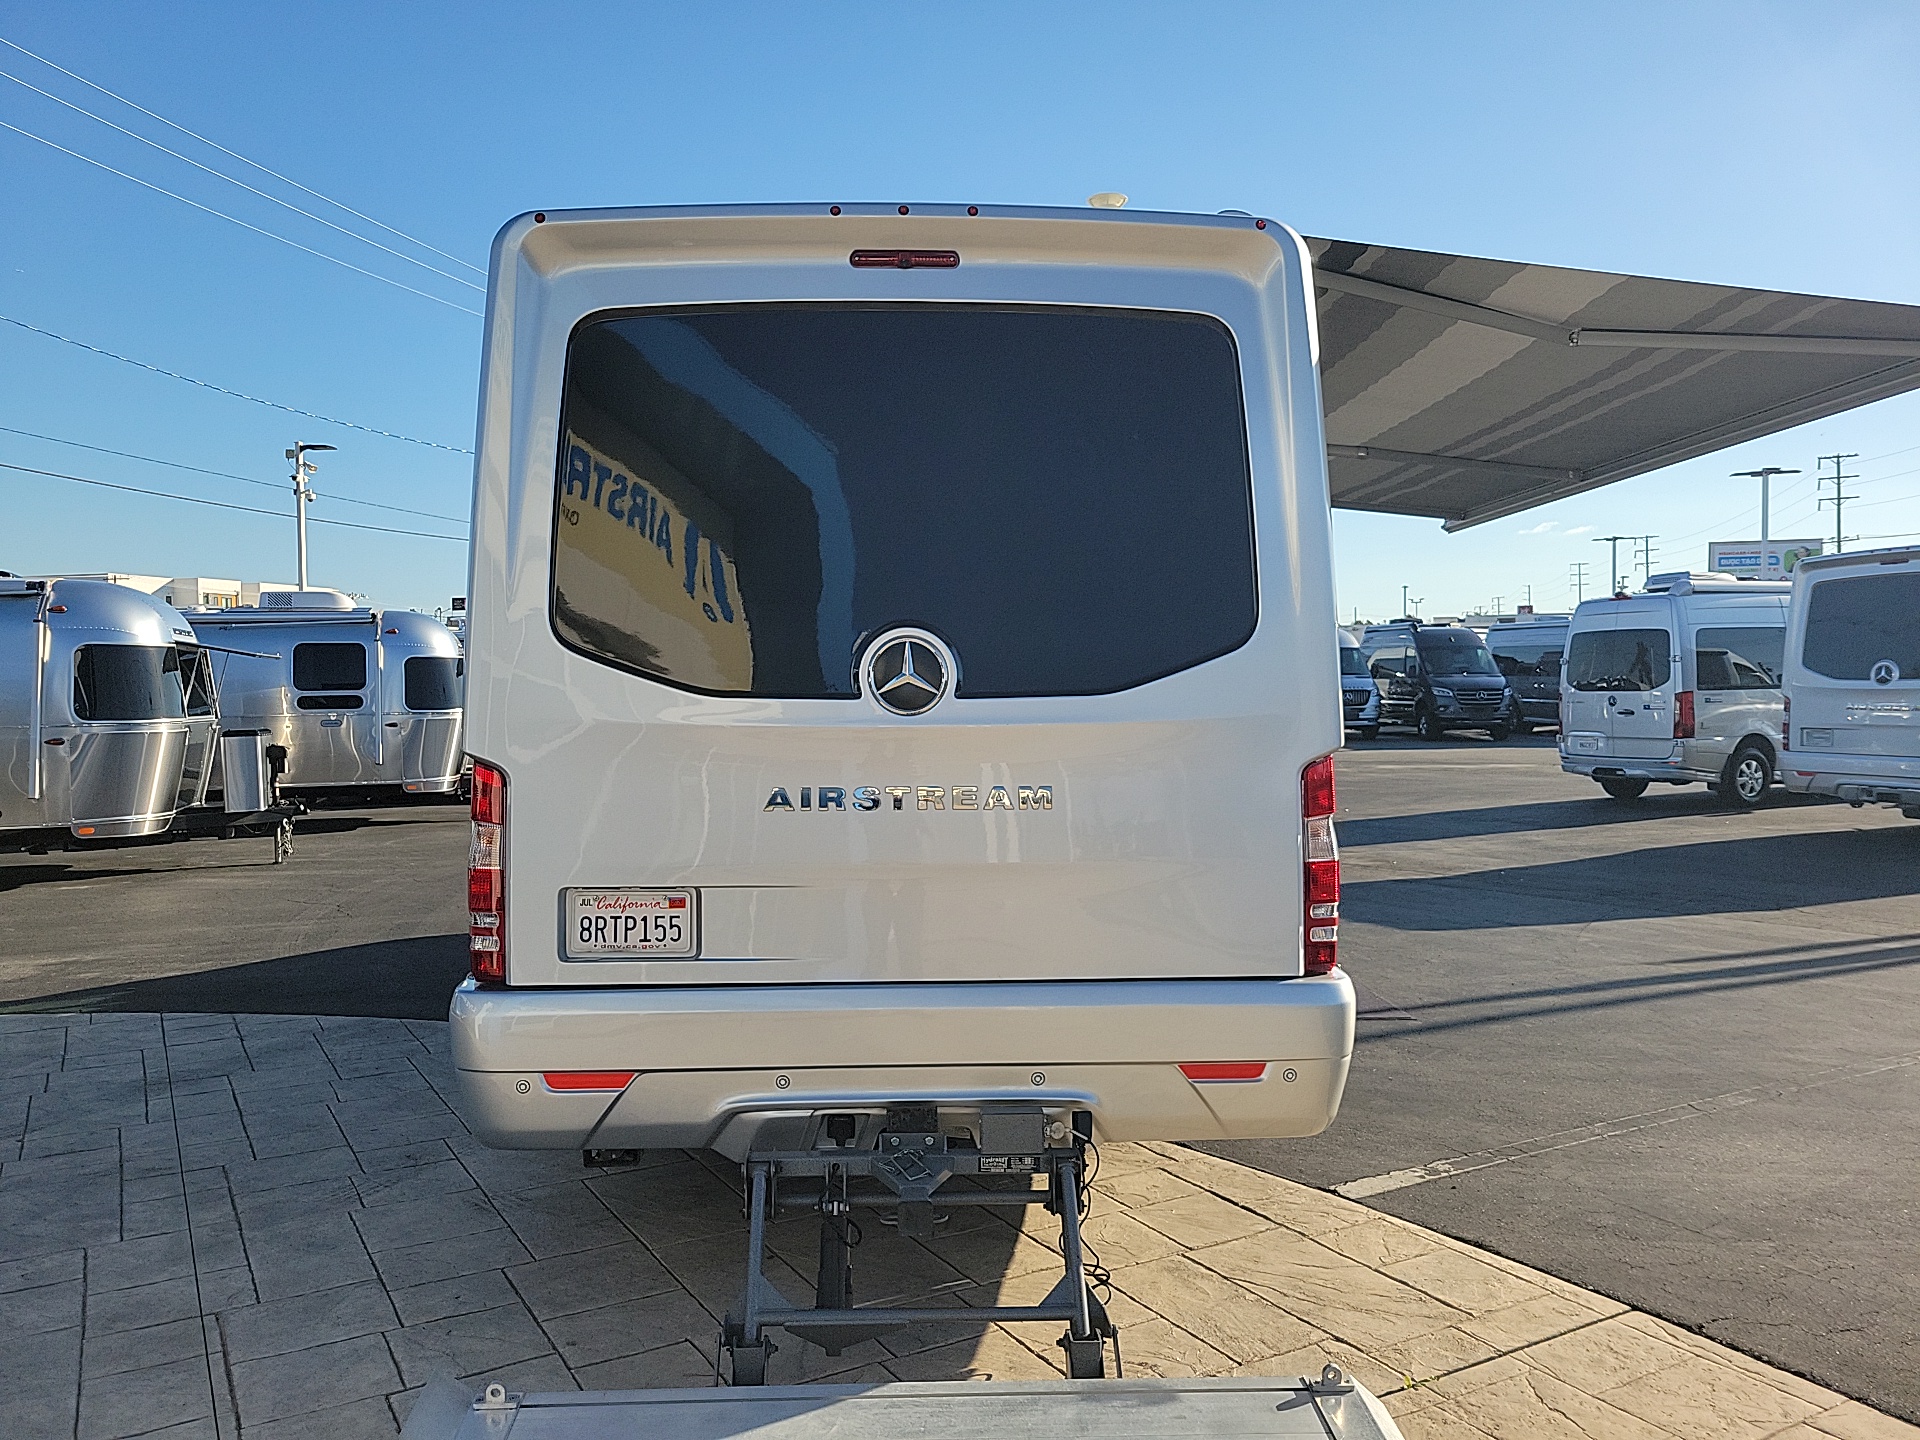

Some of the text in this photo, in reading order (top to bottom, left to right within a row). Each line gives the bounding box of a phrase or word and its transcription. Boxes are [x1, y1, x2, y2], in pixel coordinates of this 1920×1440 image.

[763, 786, 1053, 812] AIRSTREAM
[579, 897, 593, 907] JUL
[596, 896, 668, 914] California
[579, 915, 682, 943] 8RTP155
